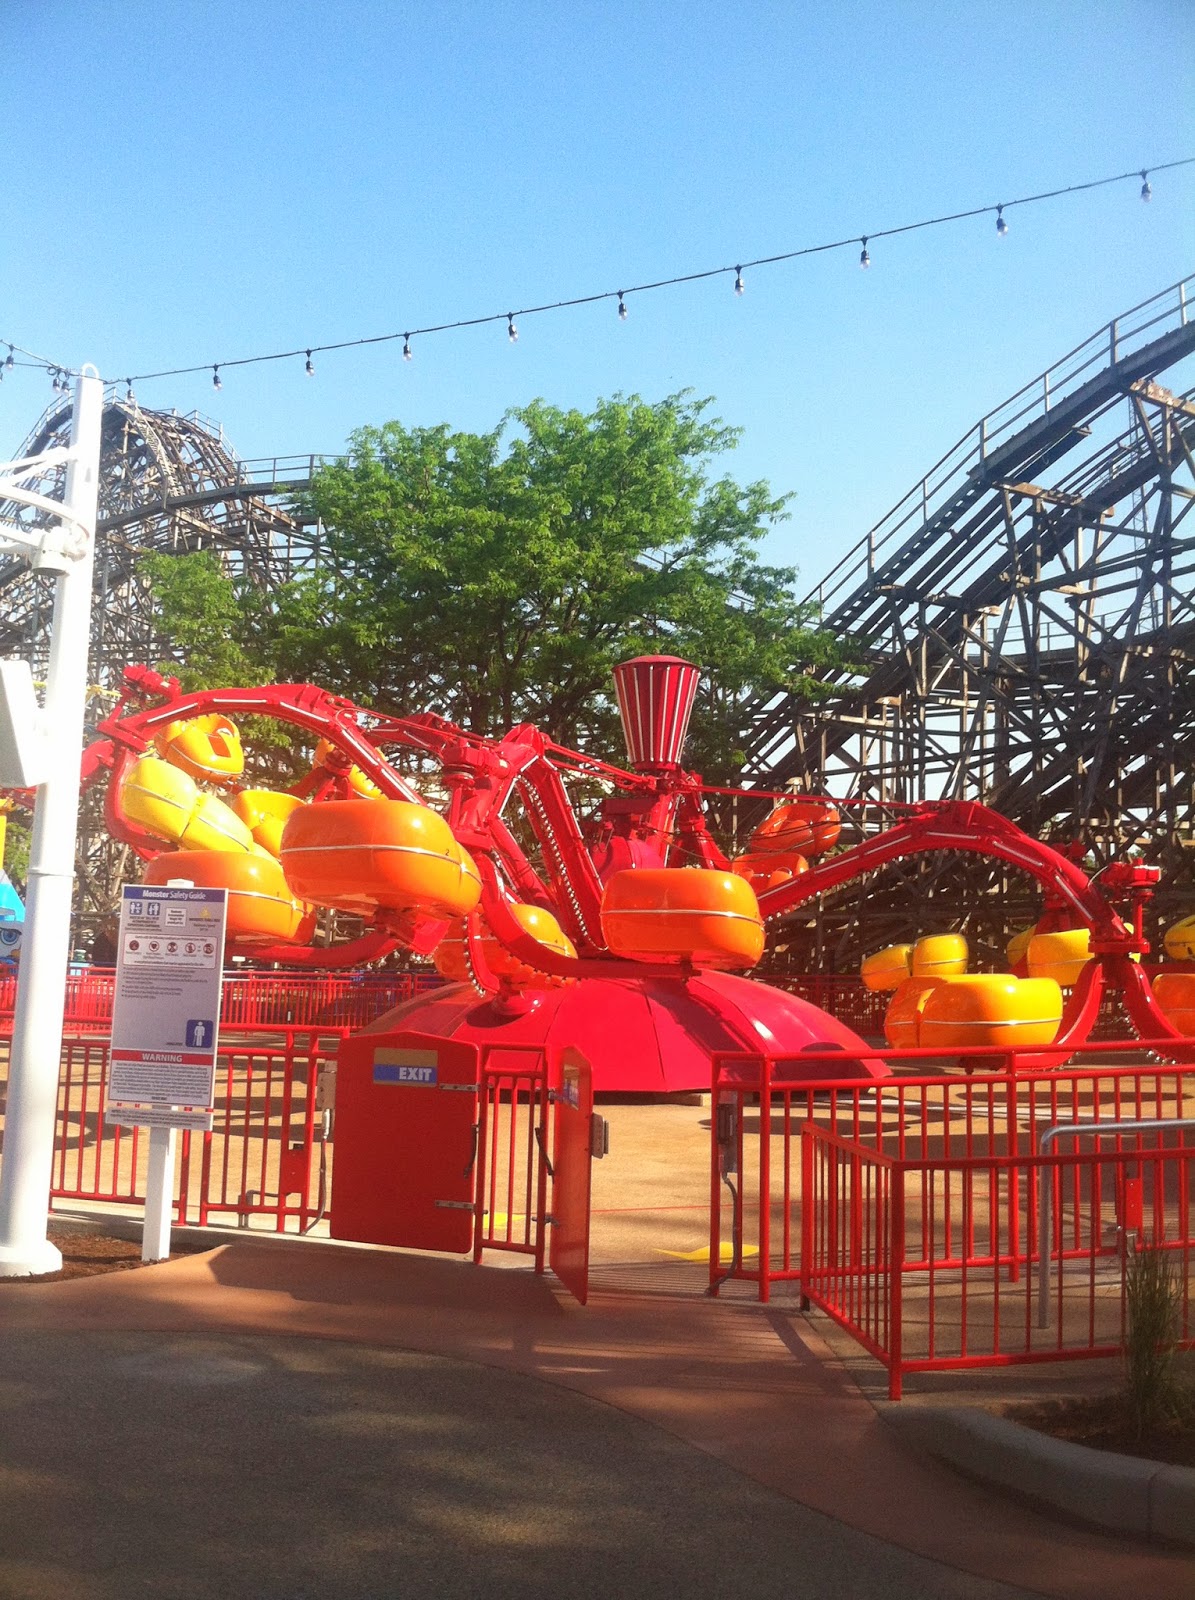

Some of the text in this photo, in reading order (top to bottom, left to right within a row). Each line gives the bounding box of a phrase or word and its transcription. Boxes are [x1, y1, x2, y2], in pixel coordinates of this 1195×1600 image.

[142, 889, 206, 900] Monster Safety Guide
[142, 1053, 183, 1062] WARNING
[399, 1067, 432, 1081] EXIT
